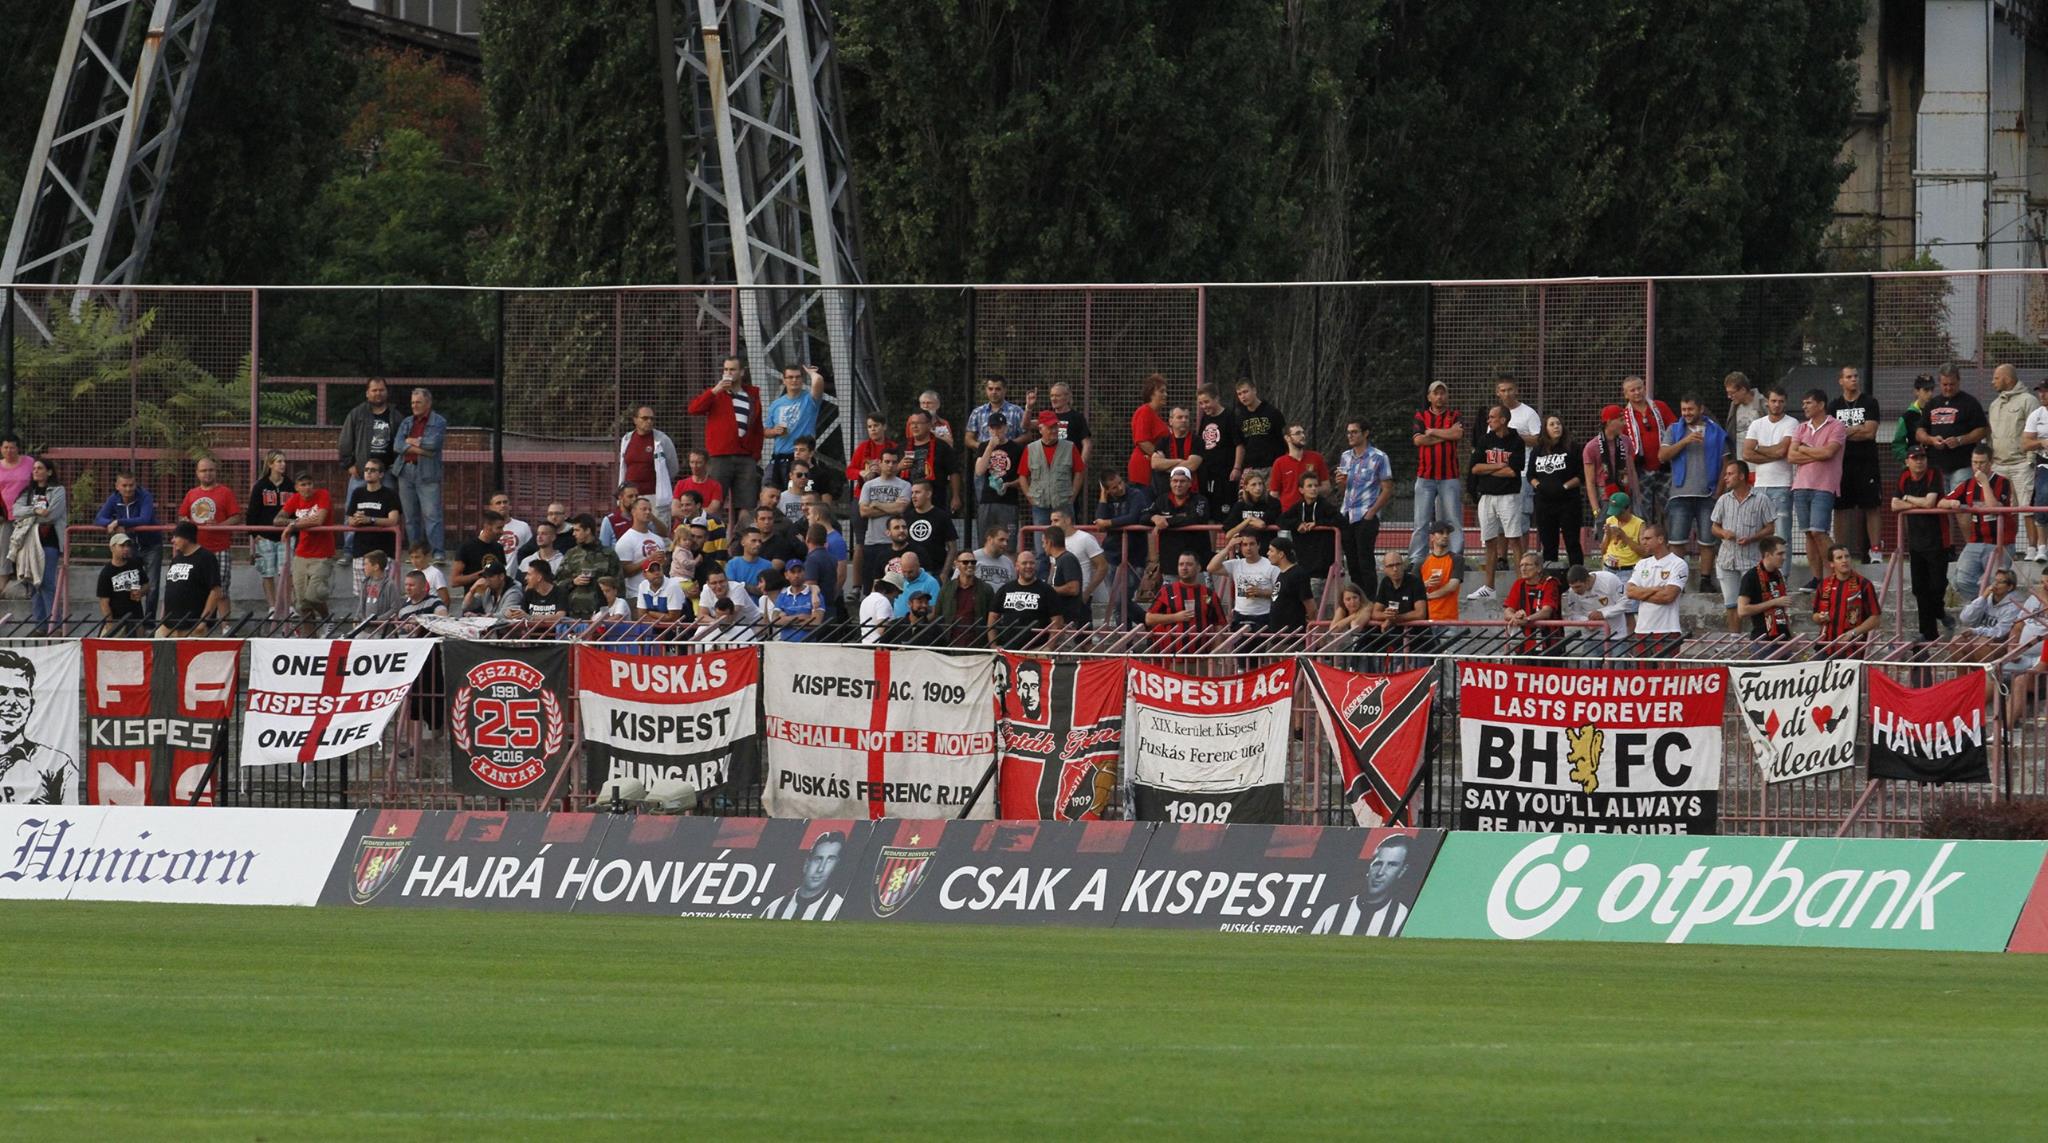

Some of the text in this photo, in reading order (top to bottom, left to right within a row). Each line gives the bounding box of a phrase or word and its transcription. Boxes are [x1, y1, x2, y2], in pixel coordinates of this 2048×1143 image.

[272, 652, 408, 676] ONE LOVE
[610, 657, 728, 694] PUSKÁS
[491, 685, 519, 698] 1991
[792, 673, 966, 704] KISPESTI AC. 1909
[1128, 667, 1290, 706] KISPESTI AC.
[1461, 667, 1720, 696] AND THOUGH NOTHING
[1739, 660, 1855, 707] Famiglia
[249, 685, 410, 715] KISPEST 1909
[1360, 704, 1381, 715] 1909
[1493, 696, 1683, 722] LASTS FOREVER
[91, 718, 221, 749] KISPES
[258, 722, 372, 748] ONE LIFE
[473, 698, 541, 749] 25
[610, 708, 730, 744] KISPEST
[766, 716, 993, 755] WE SHALL NOT BE MOVED
[1216, 720, 1257, 737] Kispest
[1781, 706, 1806, 739] di
[1873, 705, 1982, 760] HATVAN
[492, 750, 524, 762] 2016
[1139, 737, 1185, 761] Puskás
[1190, 748, 1238, 763] Ferenc
[1477, 724, 1692, 788] BH FC
[478, 762, 537, 783] KANYAR
[608, 752, 732, 792] HUNGARY
[780, 770, 850, 799] PUSKÁS
[856, 780, 932, 803] FERENC
[1072, 795, 1091, 807] 1909
[1165, 800, 1232, 824] 1909
[1465, 788, 1701, 818] SAY YOU'LL ALWAYS
[1478, 816, 1508, 832] BE
[1518, 819, 1555, 833] MY
[0, 818, 260, 886] Hunicorn
[401, 843, 776, 908] HAJRÁ HONVÉD!
[939, 866, 1327, 919] CSAK A KISPEST!
[1597, 839, 1967, 944] otpbank
